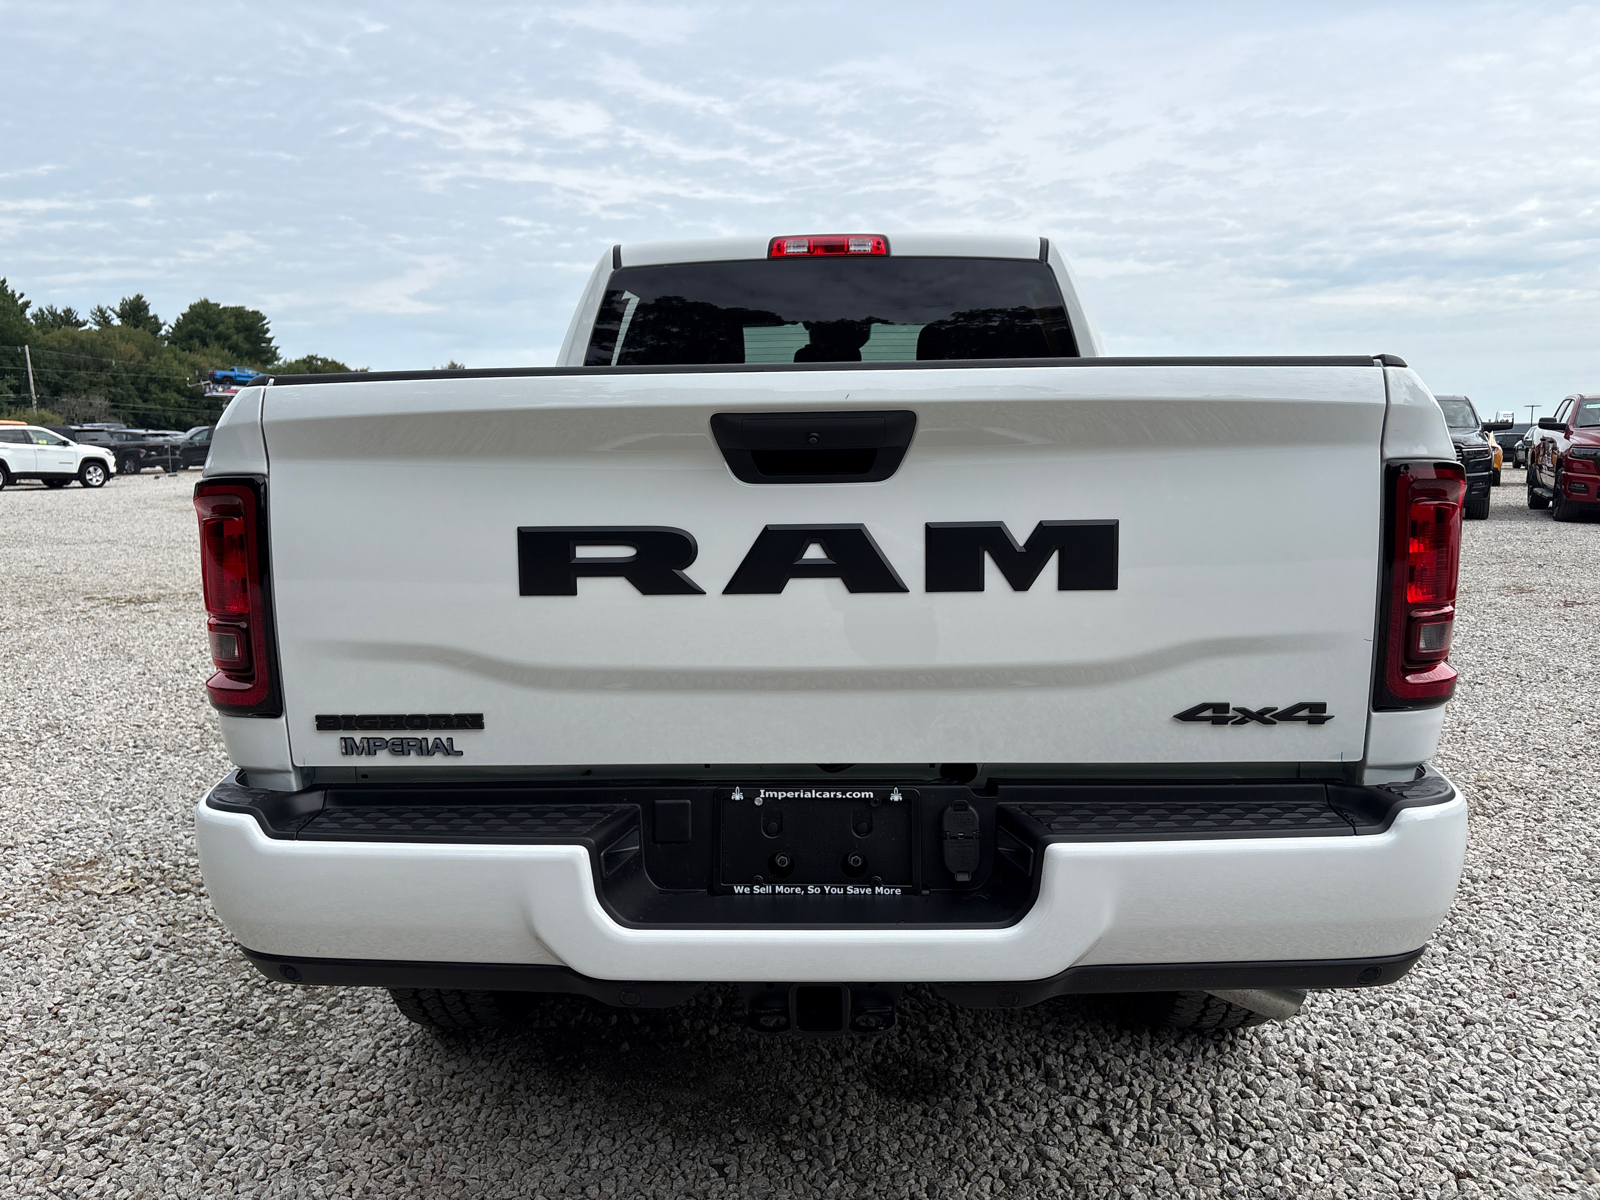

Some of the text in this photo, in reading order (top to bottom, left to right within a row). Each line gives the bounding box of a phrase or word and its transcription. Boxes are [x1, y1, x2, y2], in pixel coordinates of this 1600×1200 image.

[517, 519, 1120, 597] RAM
[314, 713, 485, 731] BIGHORN
[1172, 701, 1335, 725] 4x4
[339, 736, 463, 757] IMPERIAL
[759, 789, 874, 799] Imperialcars.com
[733, 885, 902, 896] We Sell More, So You Save More
